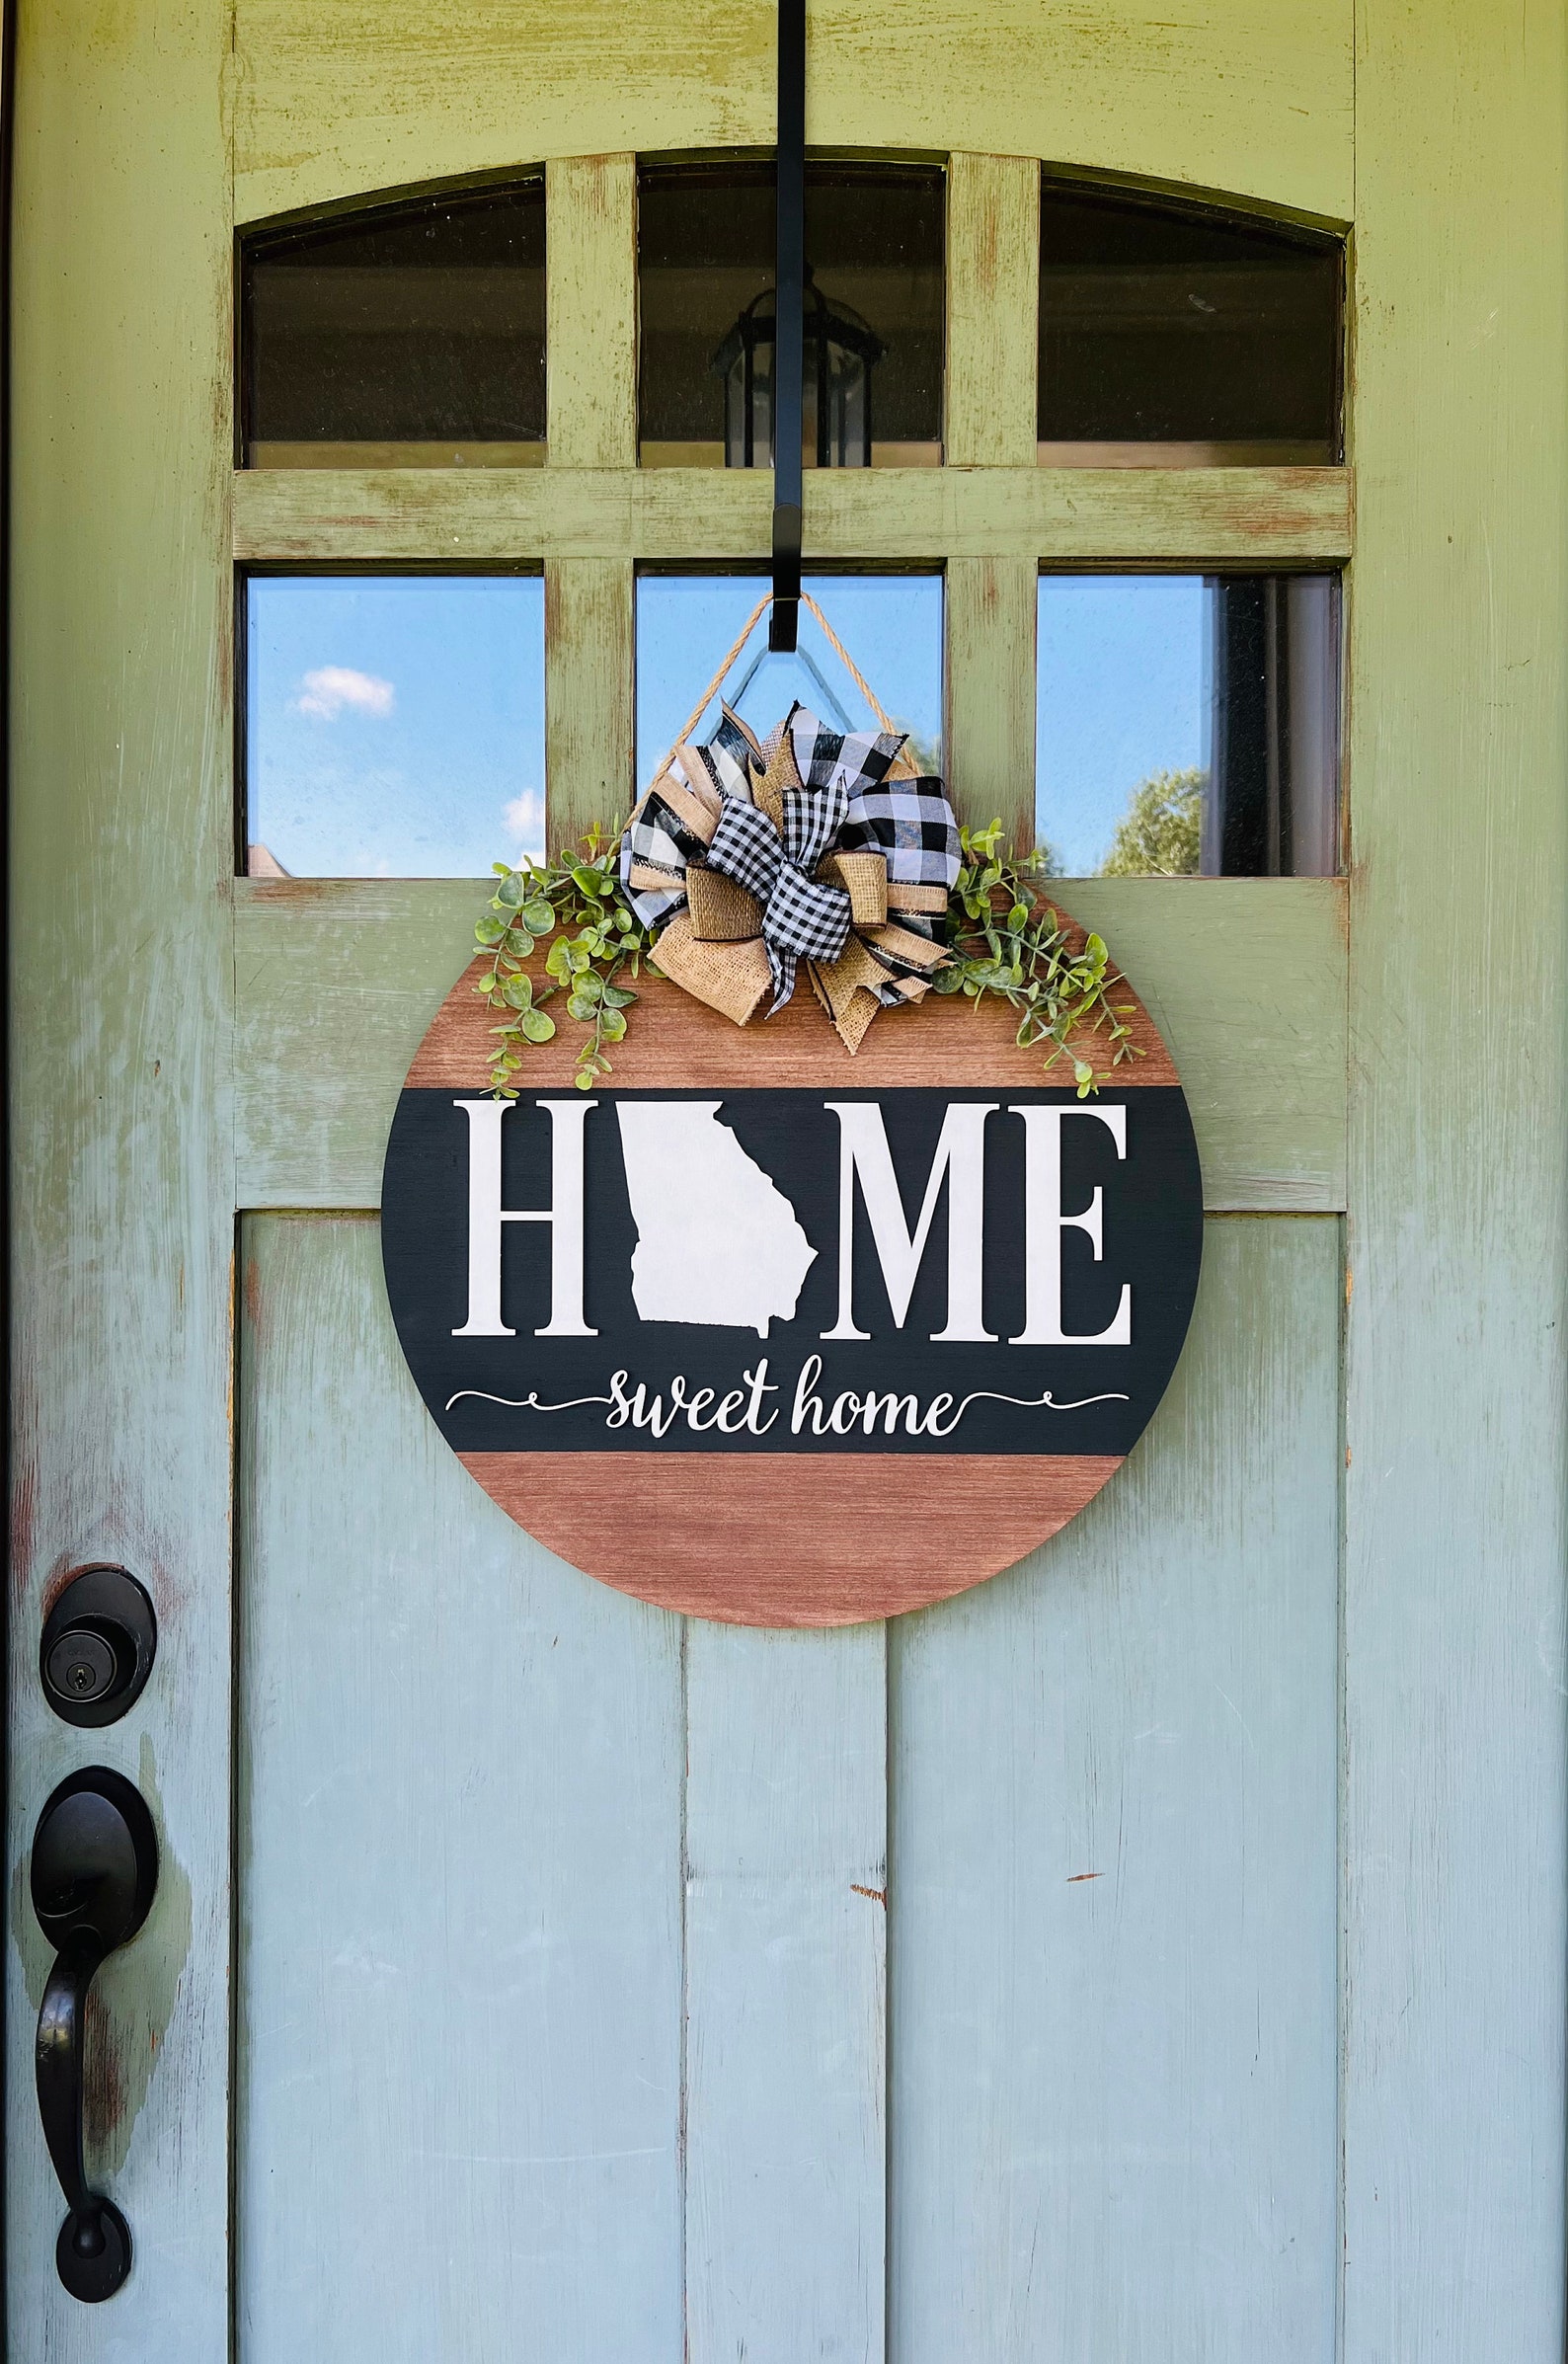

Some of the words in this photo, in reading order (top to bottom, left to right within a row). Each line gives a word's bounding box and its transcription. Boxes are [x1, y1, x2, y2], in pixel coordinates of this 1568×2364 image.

[451, 1098, 1132, 1345] HME
[605, 1358, 779, 1438] sweet
[791, 1354, 960, 1437] home
